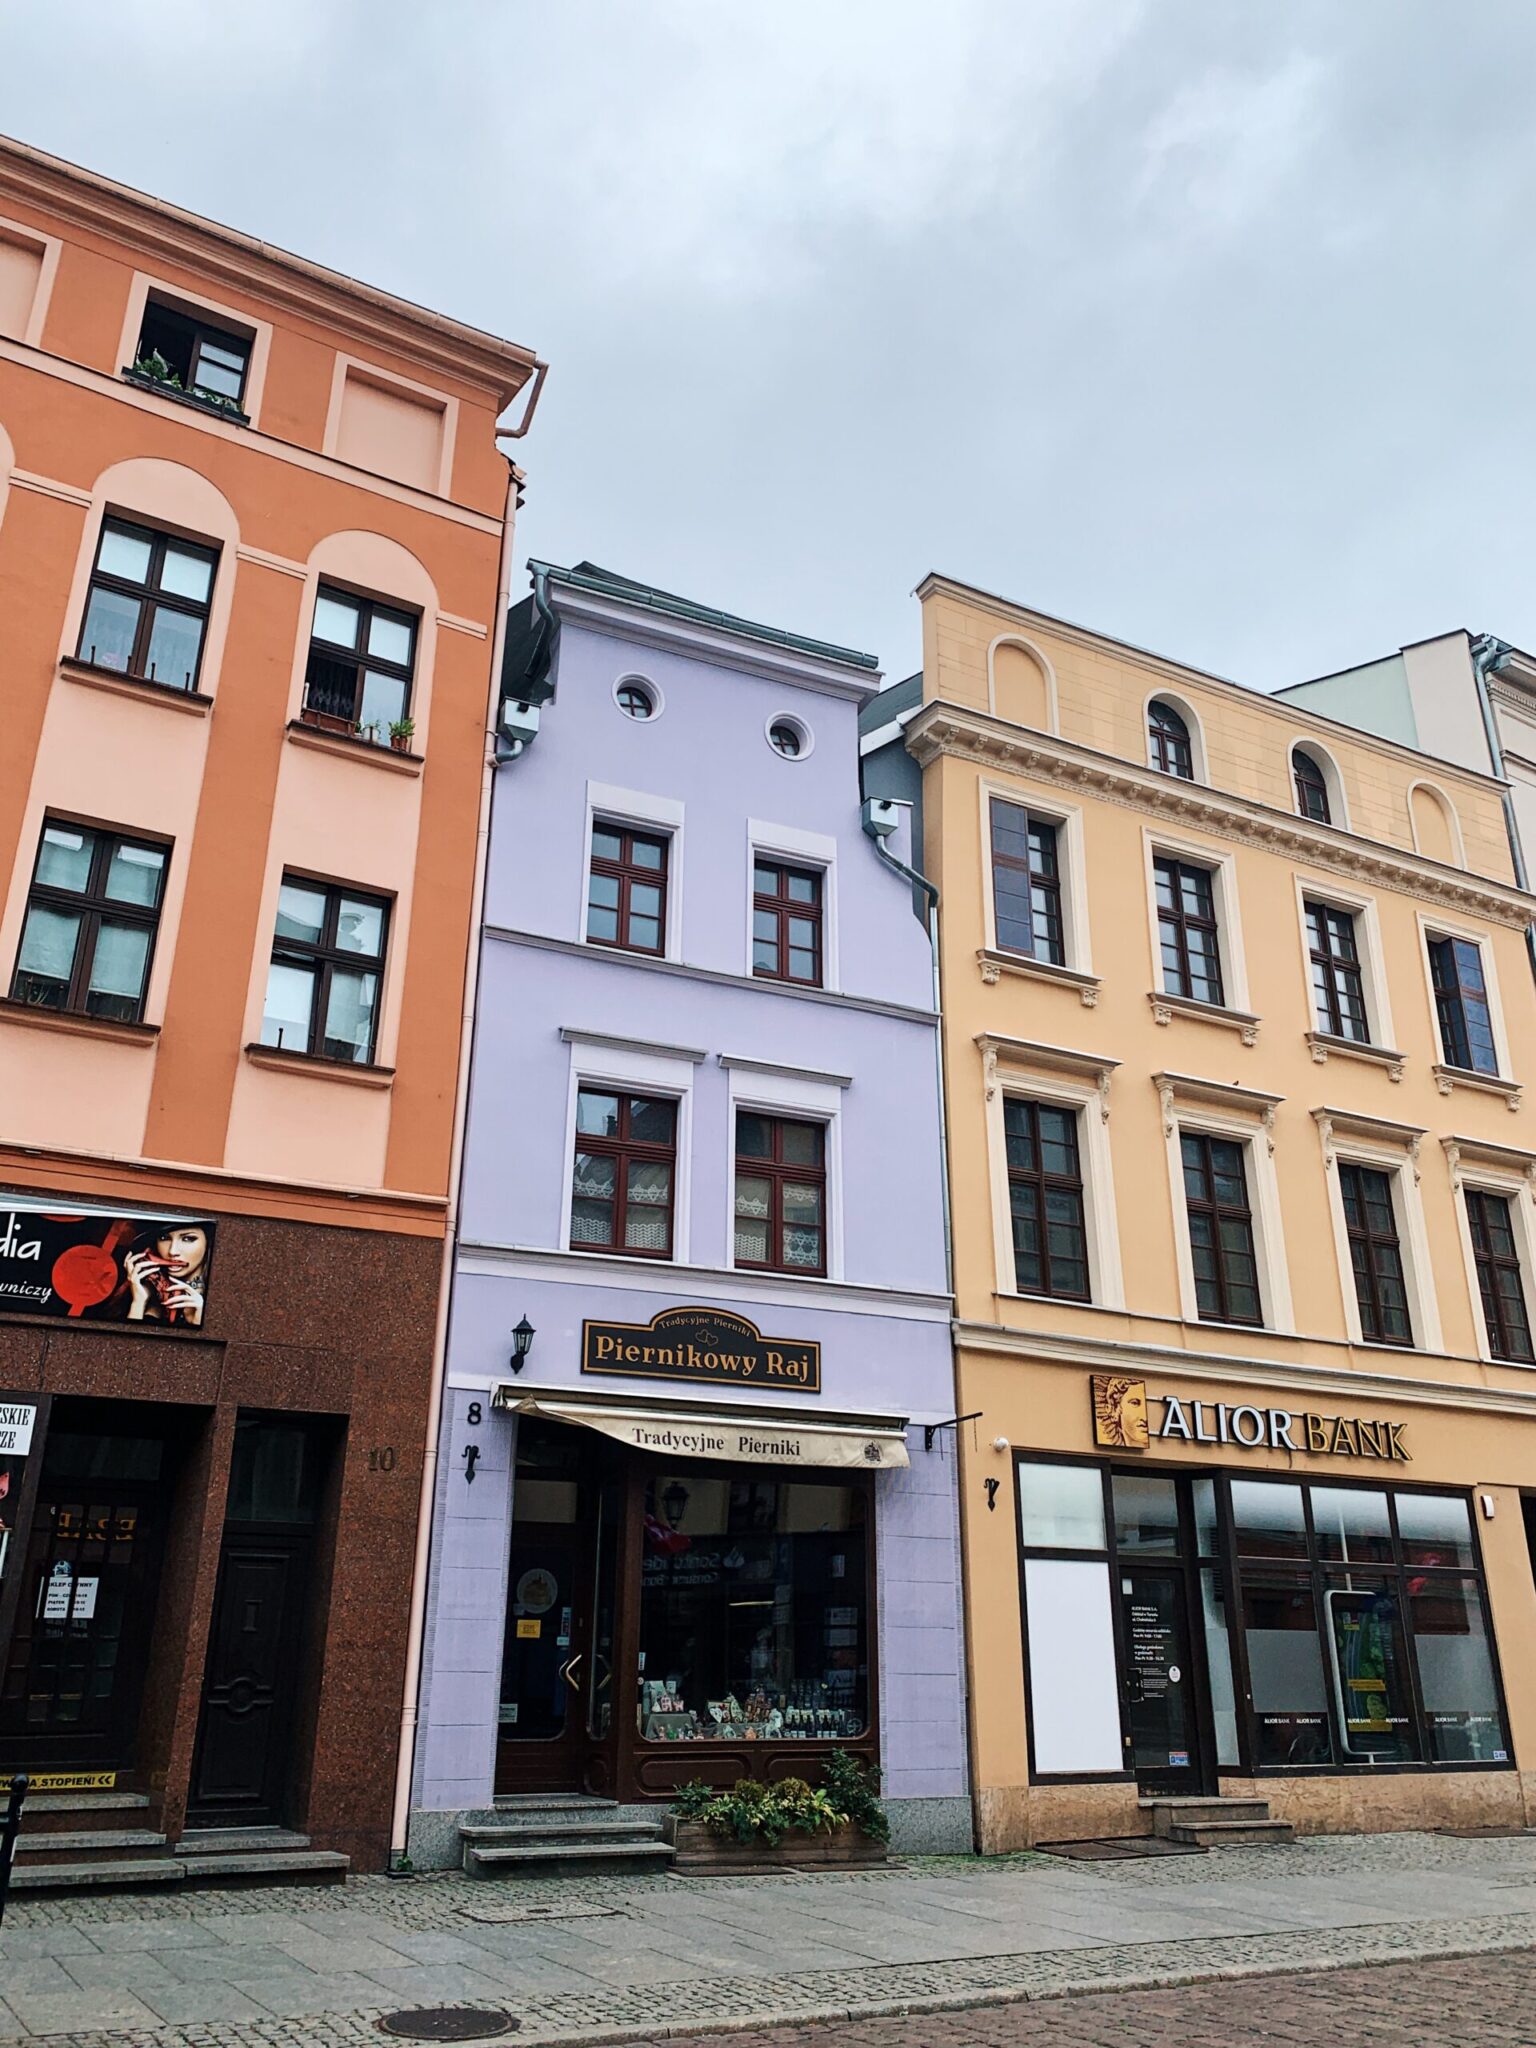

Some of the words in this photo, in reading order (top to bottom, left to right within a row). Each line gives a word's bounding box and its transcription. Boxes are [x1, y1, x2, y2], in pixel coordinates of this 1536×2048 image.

[659, 1315, 710, 1330] Tradycyjne
[713, 1317, 751, 1337] Pierniki
[595, 1335, 757, 1376] Piernikowy
[766, 1351, 809, 1382] Raj
[0, 1407, 31, 1426] SKIE
[467, 1402, 482, 1425] 8
[0, 1430, 17, 1449] ZE
[1161, 1396, 1299, 1450] ALIOR
[1304, 1412, 1414, 1462] BANK
[631, 1427, 725, 1452] Tradycyjne
[738, 1435, 801, 1457] Pierniki
[368, 1447, 395, 1471] 10
